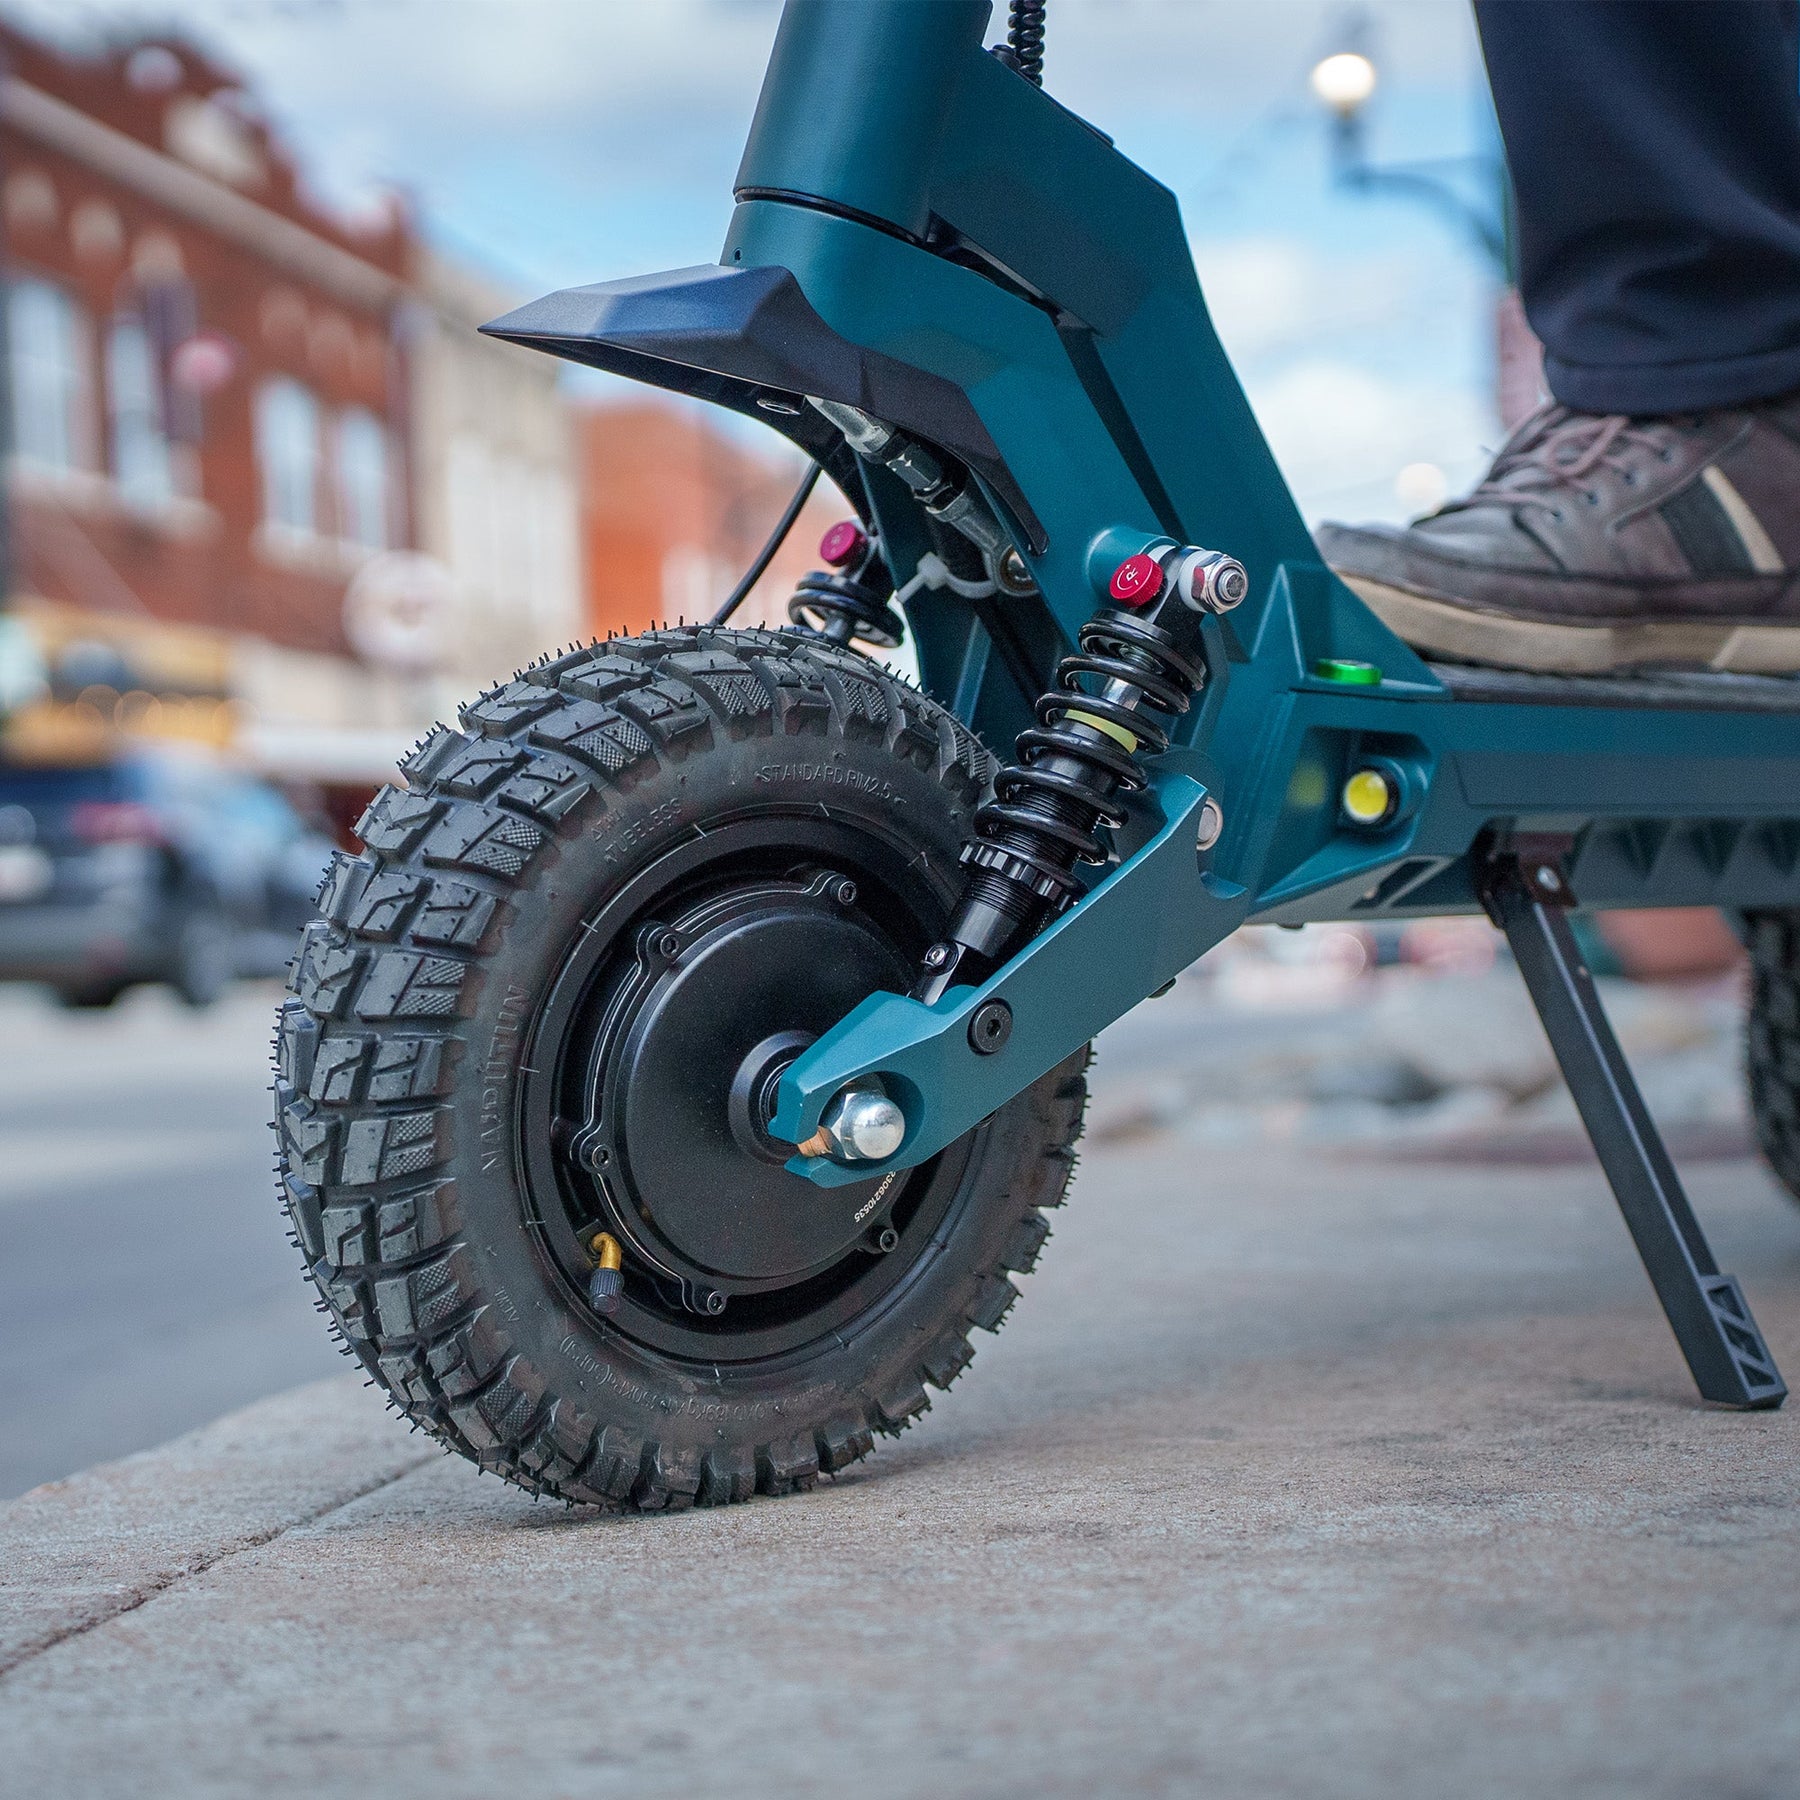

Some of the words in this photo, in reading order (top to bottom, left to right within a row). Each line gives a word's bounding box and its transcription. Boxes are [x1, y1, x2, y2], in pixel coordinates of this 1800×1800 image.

[1126, 568, 1138, 581] R
[760, 764, 845, 785] STANDARD
[603, 796, 683, 858] TUBELESS
